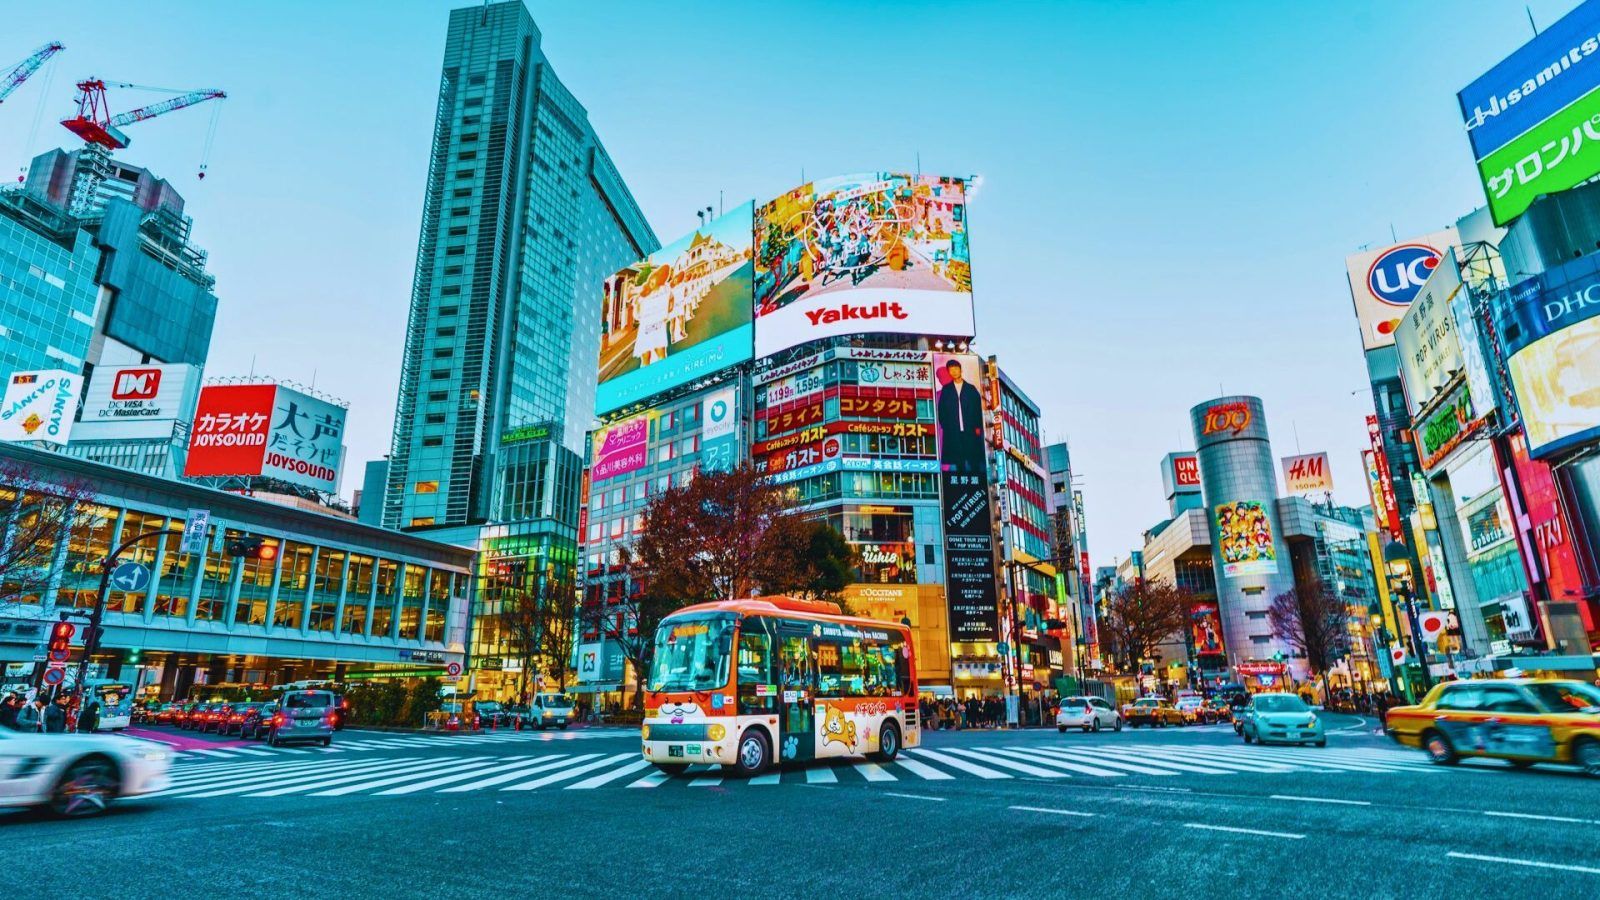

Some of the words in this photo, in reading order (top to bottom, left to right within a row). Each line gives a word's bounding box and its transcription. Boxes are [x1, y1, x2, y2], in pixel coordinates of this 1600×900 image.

[1464, 32, 1600, 131] Hisamits
[804, 302, 908, 326] Yakult
[1544, 283, 1600, 323] DHC
[883, 366, 929, 381] しゃぶ葉
[1, 378, 56, 420] SANKYO
[47, 377, 73, 436] SANKYO
[108, 401, 120, 409] DC
[123, 400, 143, 408] VISA
[756, 393, 767, 403] 9F
[841, 398, 914, 414] コンタクト
[98, 409, 110, 417] DC
[113, 407, 161, 417] MasterCard
[197, 412, 268, 433] カラオケ
[273, 401, 342, 441] 大声
[768, 404, 823, 432] プライス
[1202, 408, 1252, 437] 109
[193, 432, 266, 447] JOYSOUND
[800, 426, 828, 444] ガスト
[893, 422, 928, 437] ガスト
[265, 451, 336, 482] JOYSOUND
[755, 461, 768, 473] 7F
[785, 447, 820, 470] ガスト
[873, 460, 938, 470] 英会話イーオン
[1289, 456, 1323, 481] H&M
